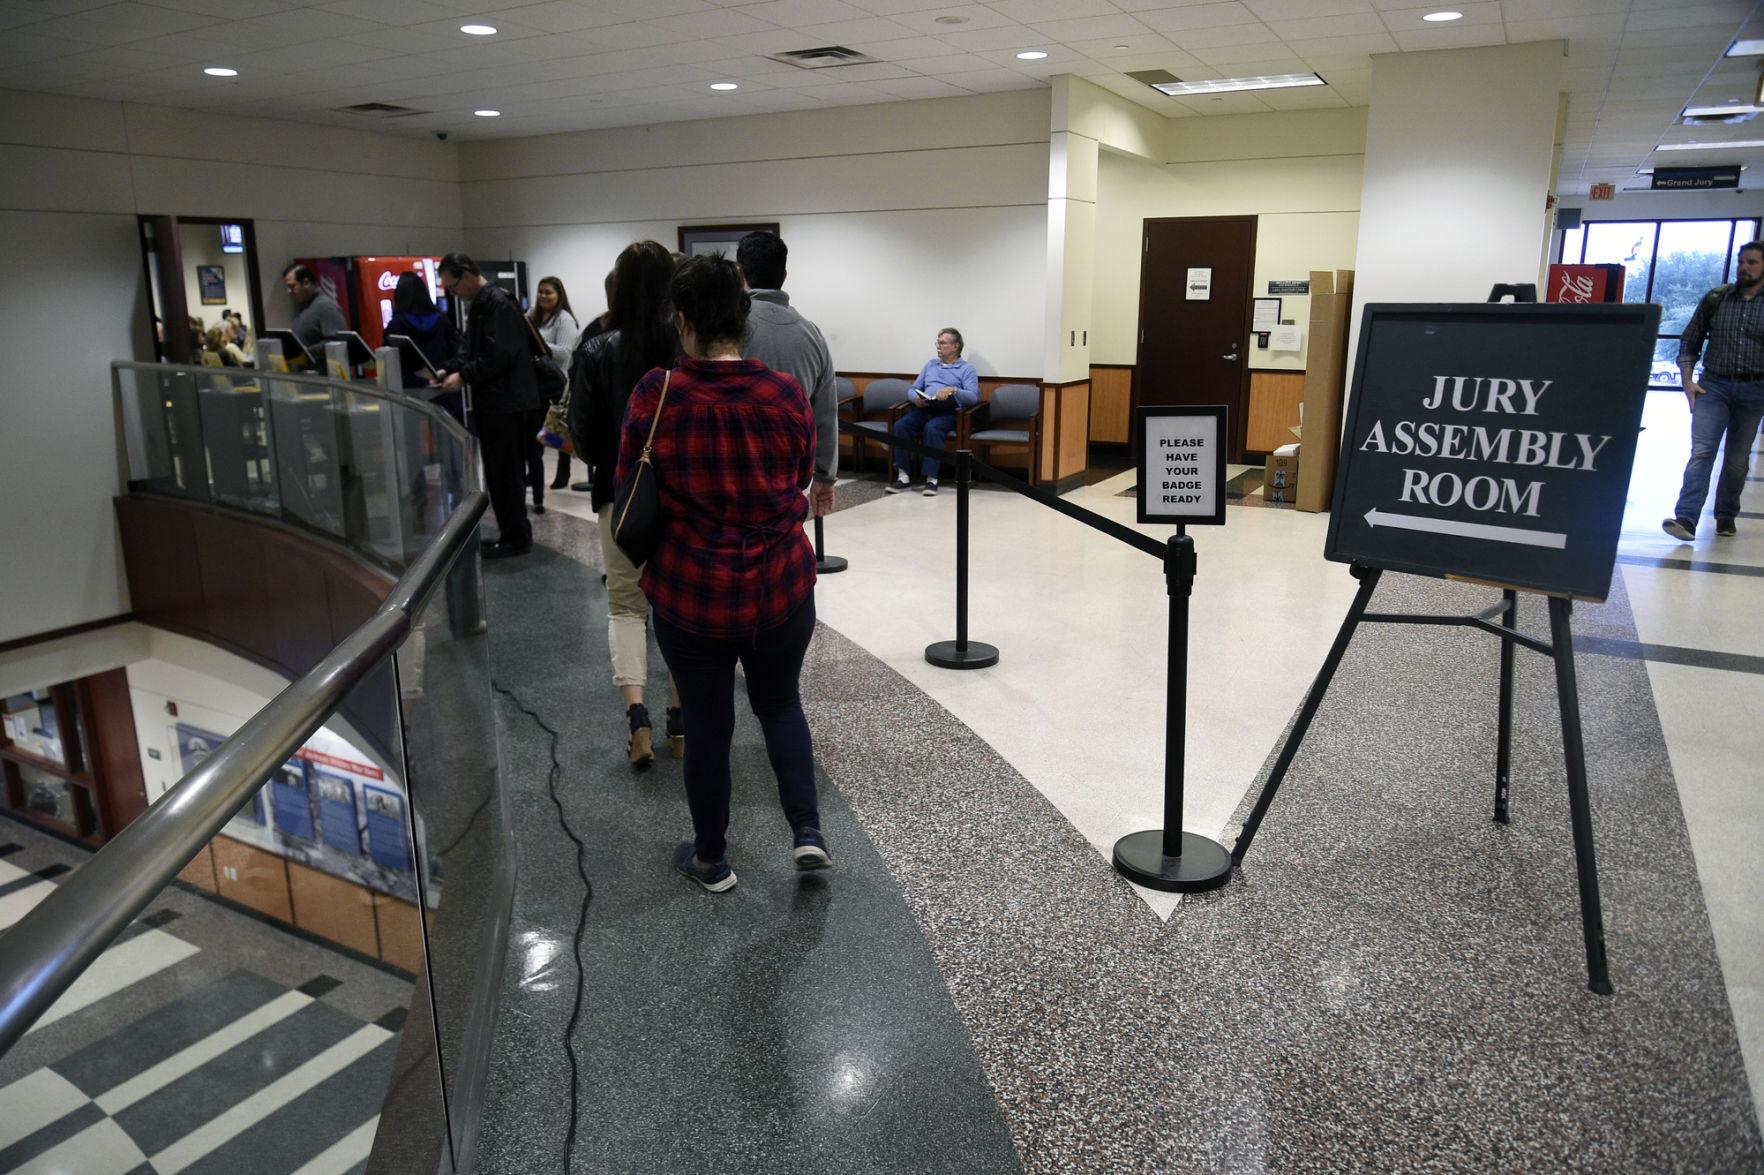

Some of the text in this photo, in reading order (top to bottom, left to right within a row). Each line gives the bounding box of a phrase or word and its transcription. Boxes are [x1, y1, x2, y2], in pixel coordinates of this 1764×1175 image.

[1694, 178, 1714, 187] Jury
[1592, 186, 1612, 199] EXIT
[1422, 375, 1553, 416] JURY
[1159, 438, 1205, 448] PLEASE
[1359, 419, 1612, 471] ASSEMBLY
[1166, 453, 1198, 461] HAVE
[1165, 467, 1198, 475] YOUR
[1162, 481, 1202, 490] BADGE
[1397, 468, 1546, 518] ROOM
[1162, 495, 1202, 504] READY
